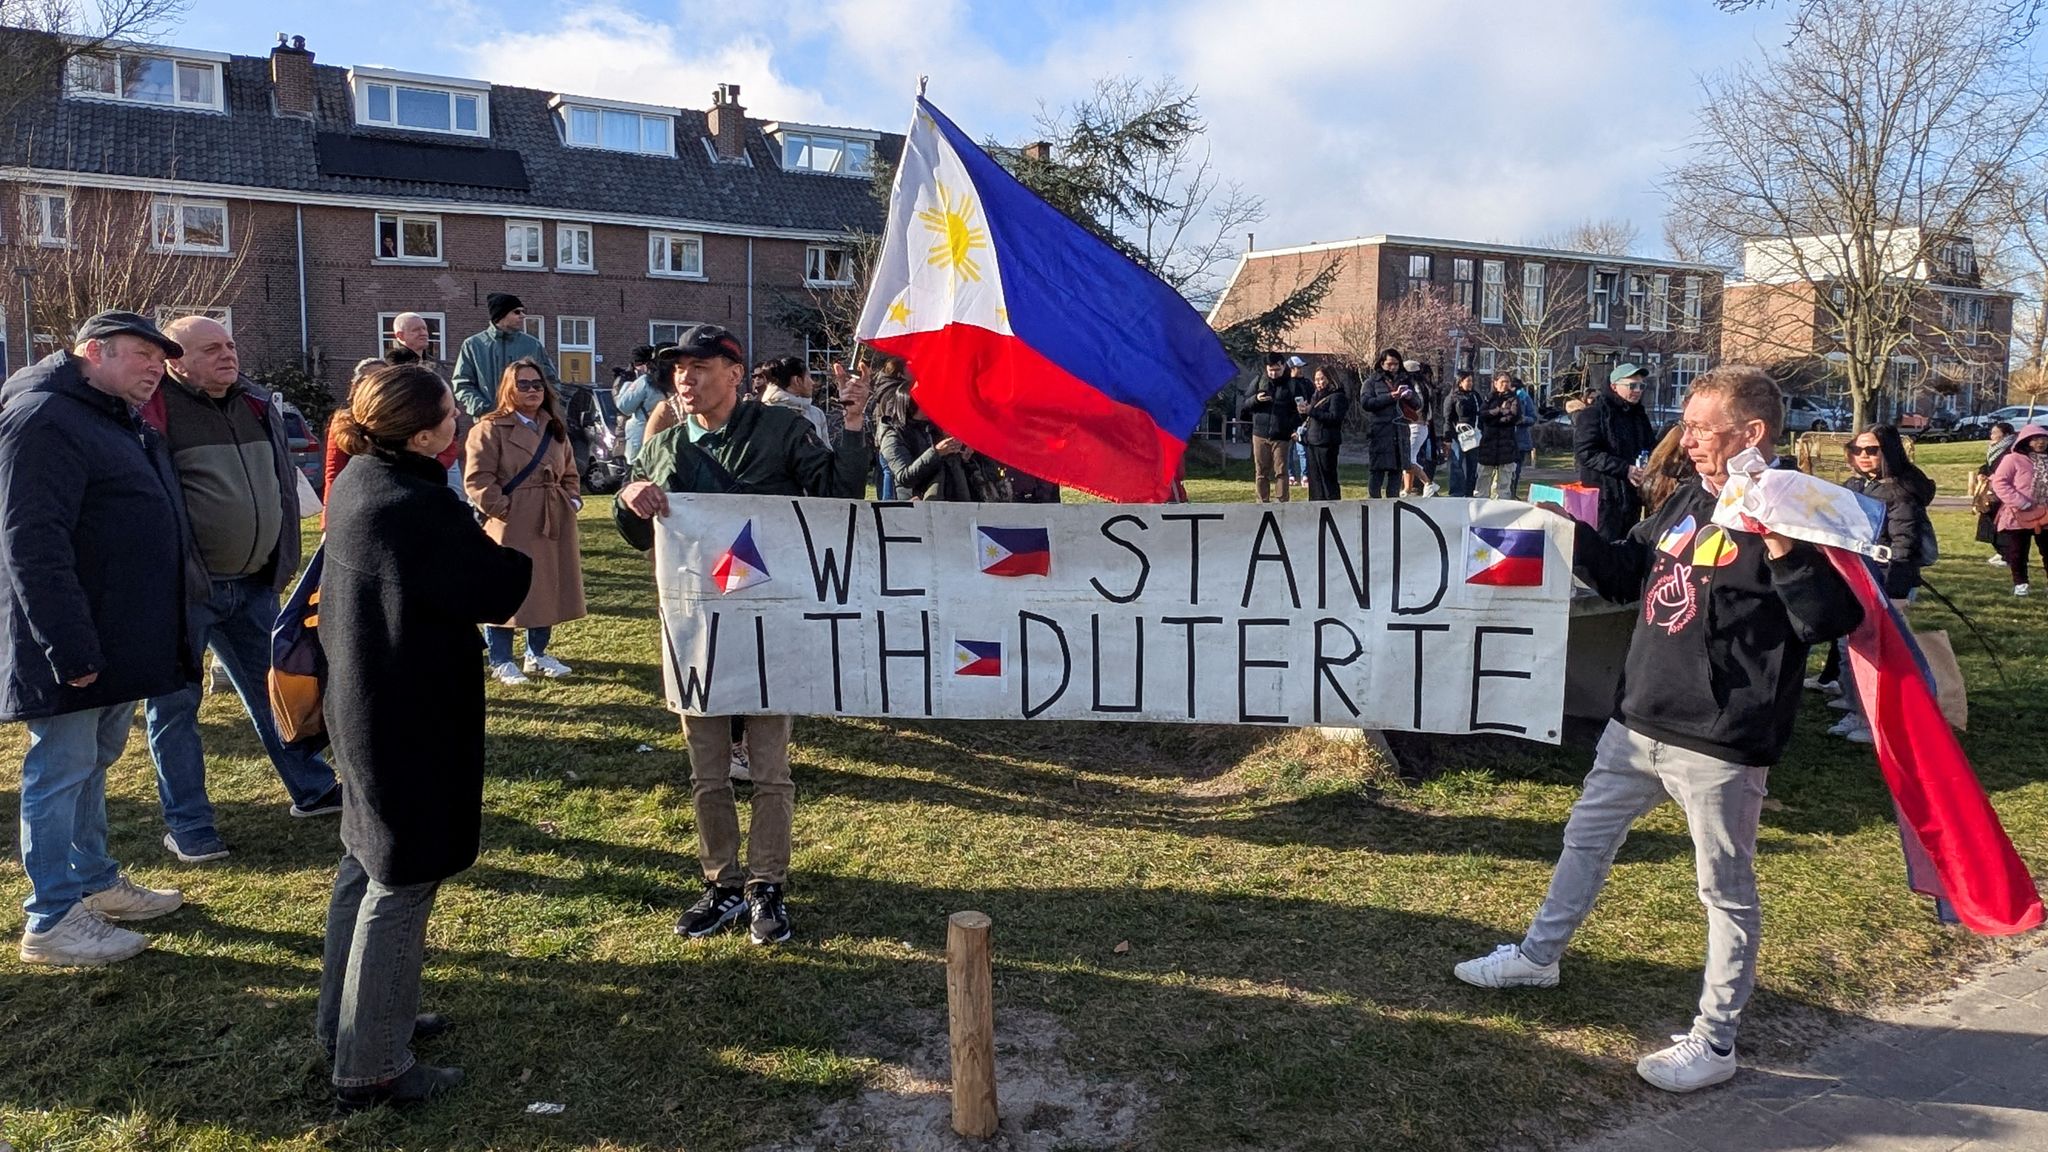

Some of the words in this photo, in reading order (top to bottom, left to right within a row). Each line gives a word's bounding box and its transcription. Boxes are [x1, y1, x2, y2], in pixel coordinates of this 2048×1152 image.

[791, 500, 926, 604] WE
[1089, 500, 1449, 615] STAND
[659, 609, 932, 716] WITH
[1018, 609, 1535, 734] DUTERTE
